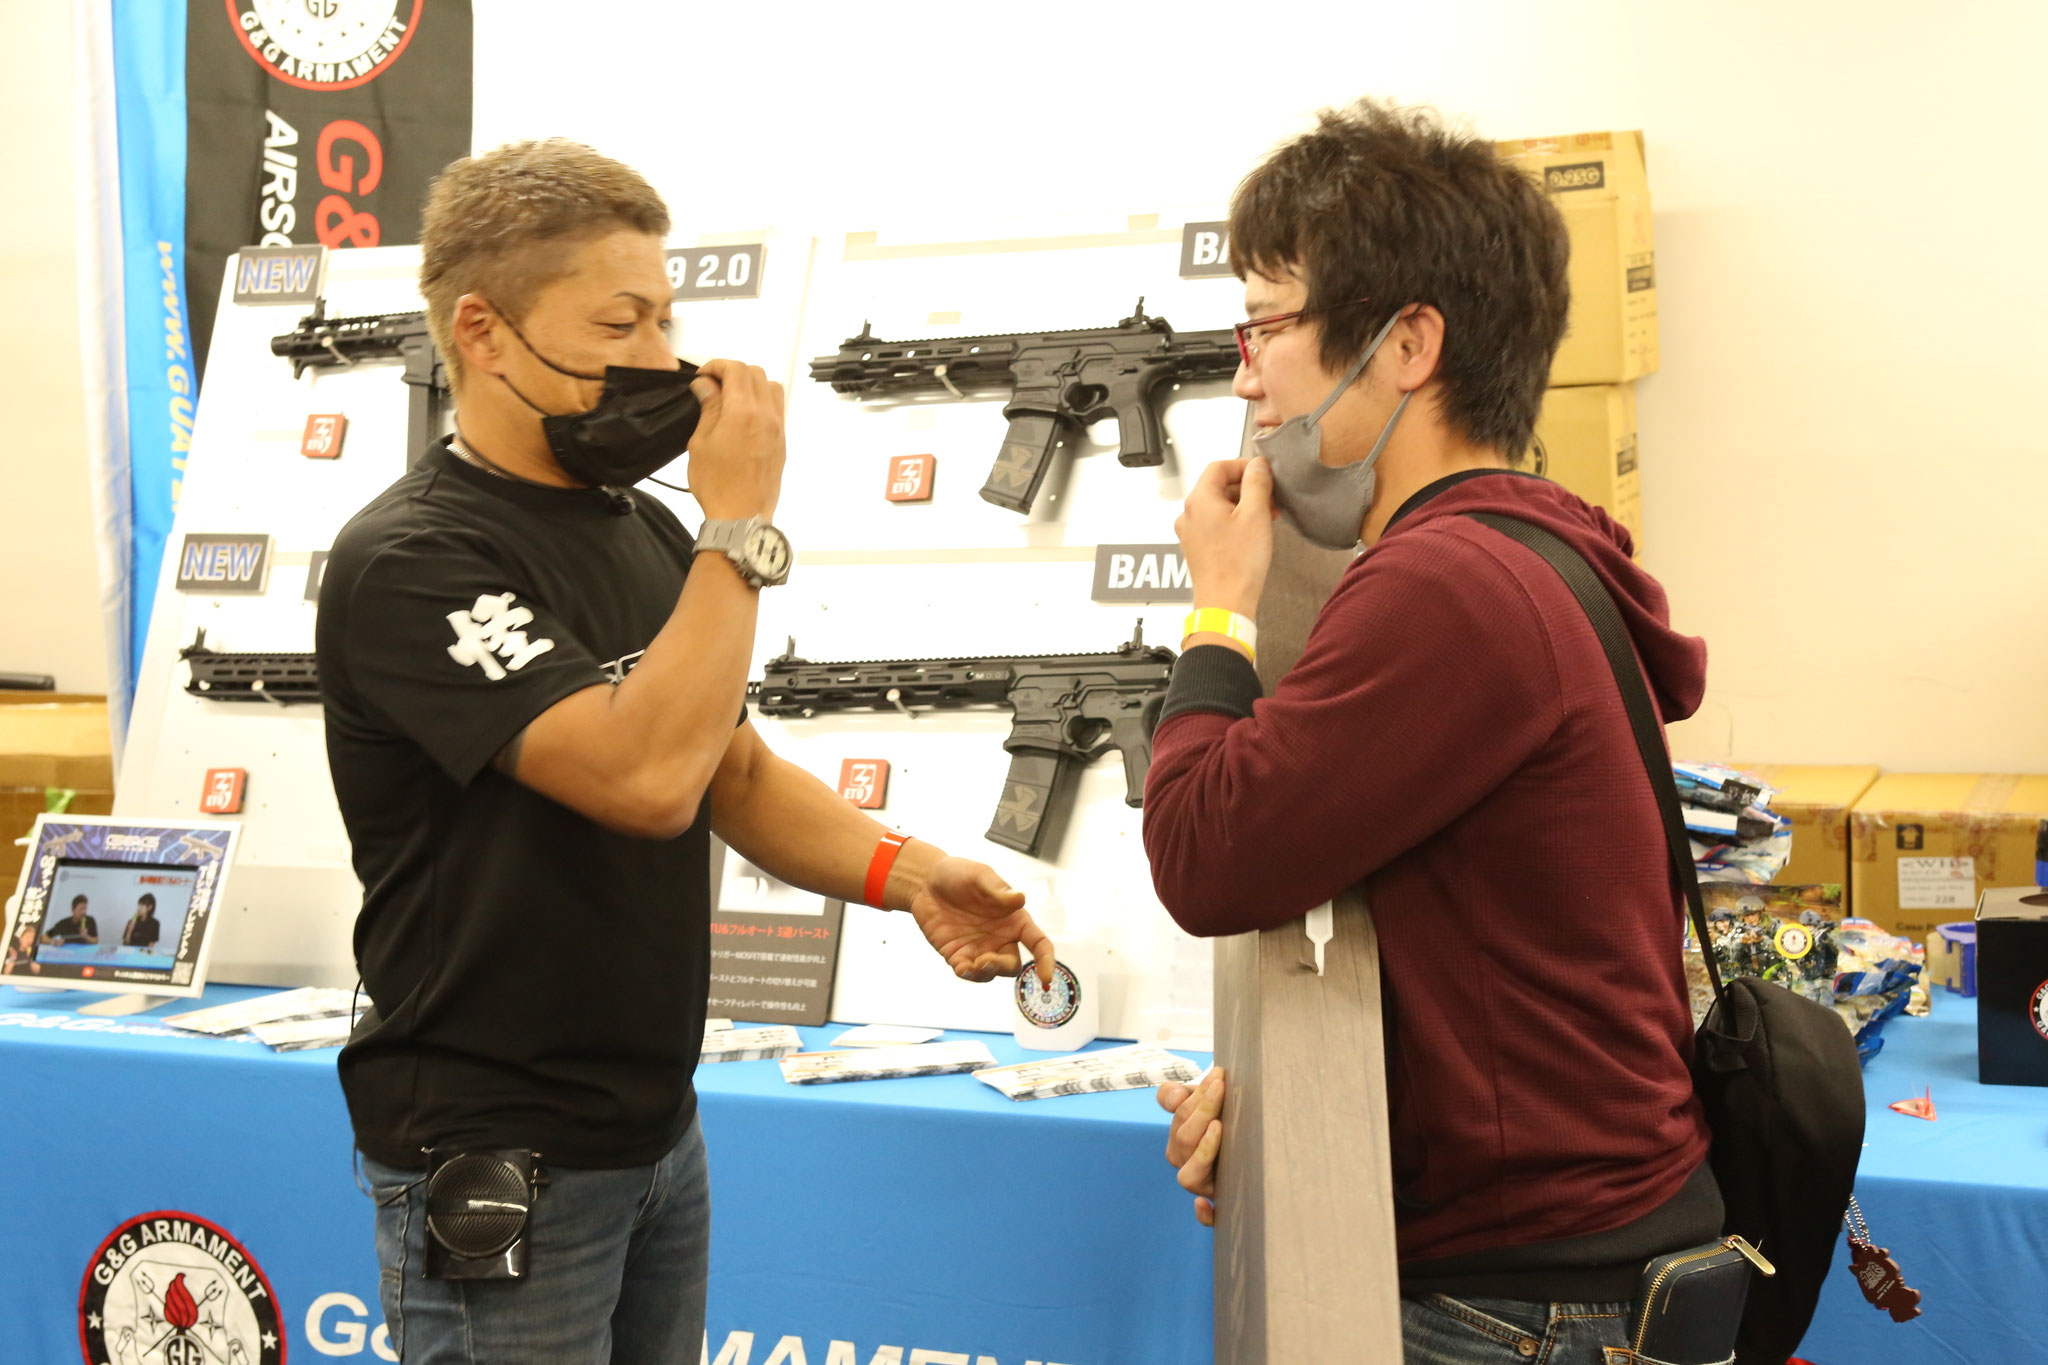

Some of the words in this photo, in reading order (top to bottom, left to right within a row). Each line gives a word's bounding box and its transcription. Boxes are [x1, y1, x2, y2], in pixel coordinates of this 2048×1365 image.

[239, 10, 281, 63] G&G
[279, 16, 408, 83] ARMAMENT
[237, 256, 318, 294] NEW
[696, 252, 751, 288] 2.0
[181, 542, 262, 582] NEW
[1108, 553, 1193, 589] BAM
[94, 1233, 138, 1286] G&G
[140, 1219, 268, 1300] ARMAMENT
